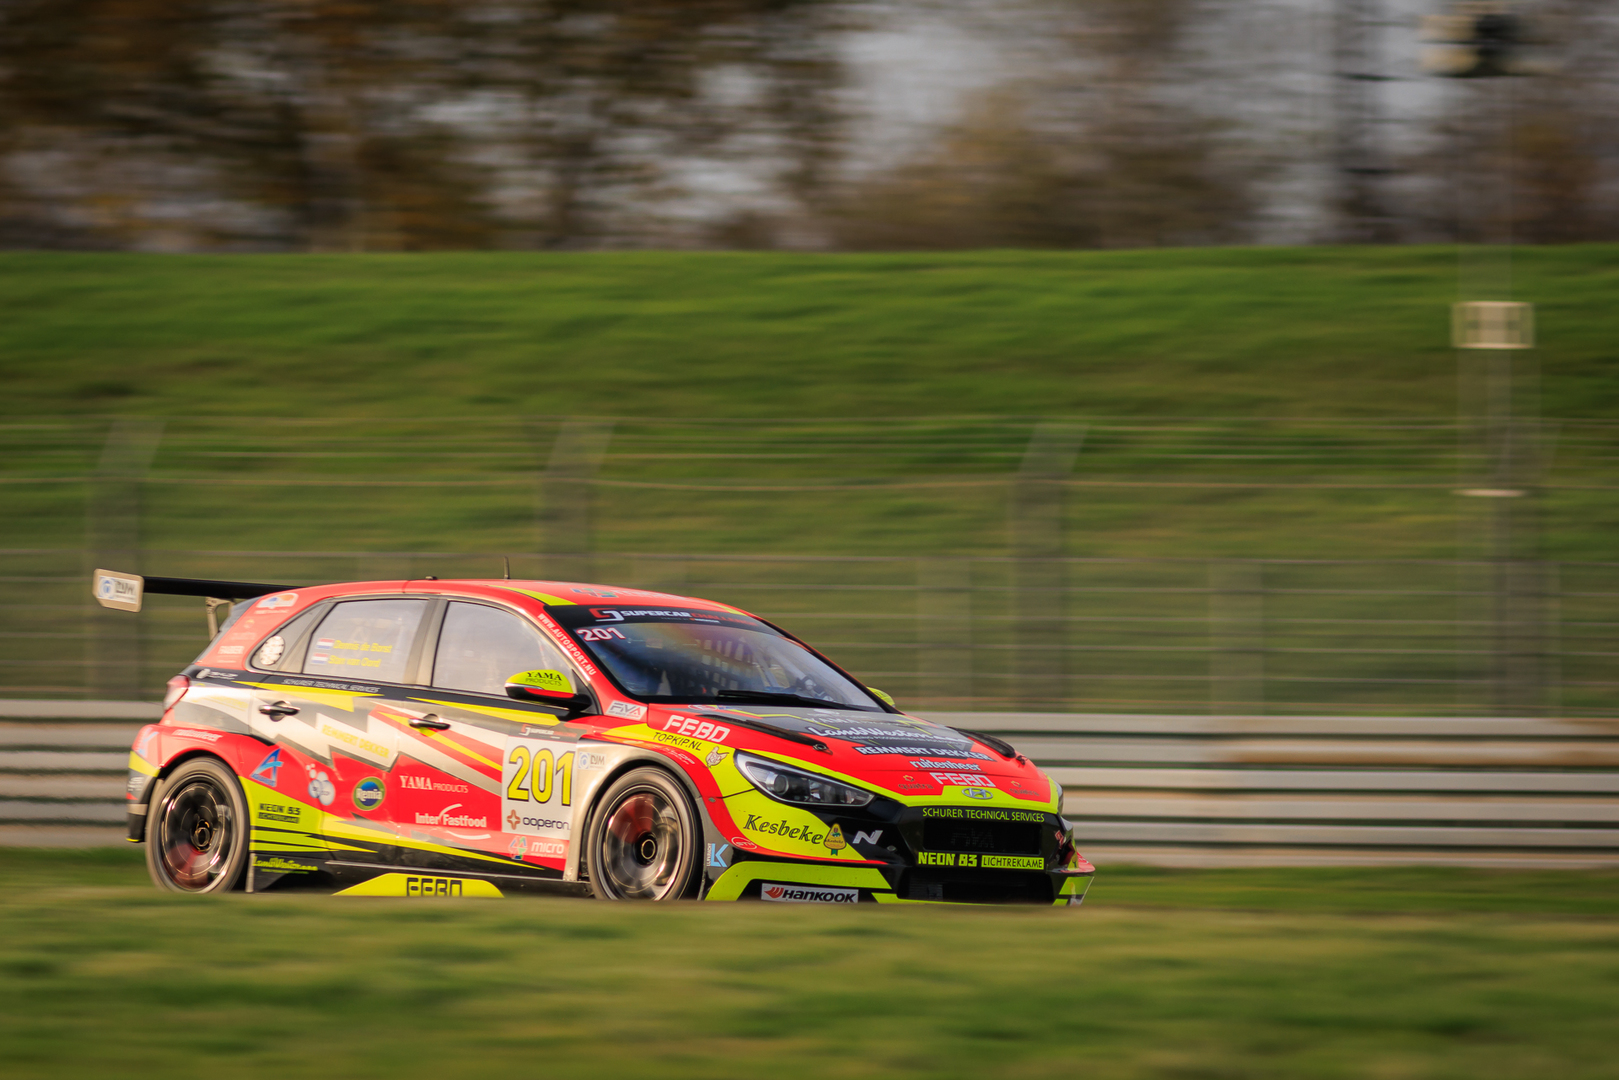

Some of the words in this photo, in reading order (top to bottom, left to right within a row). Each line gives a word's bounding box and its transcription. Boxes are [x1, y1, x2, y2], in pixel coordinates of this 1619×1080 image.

[622, 610, 692, 618] SUPERCAR
[576, 627, 626, 642] 201
[333, 639, 360, 651] Dennis
[360, 642, 370, 651] de
[537, 613, 596, 676] WWW.AUTOSPORT.NU
[525, 678, 563, 686] PRODUCTS
[527, 672, 563, 681] YAMA
[314, 681, 350, 690] TECHNICAL
[350, 684, 381, 693] SERVICES
[663, 714, 731, 743] FEBO
[322, 724, 359, 746] REMMERT
[358, 738, 390, 759] DEKKER
[653, 731, 702, 751] TOPKIP.NL
[858, 746, 933, 756] REMMERT
[933, 748, 998, 762] DEKKER
[909, 757, 983, 772] ruitenheer
[399, 775, 433, 790] YAMA
[433, 783, 469, 793] PRODUCTS
[507, 745, 576, 807] 201
[929, 772, 996, 788] FEBO
[356, 787, 382, 802] Remia
[259, 803, 285, 813] NEON
[922, 807, 963, 818] SCHURER
[965, 809, 1010, 820] TECHNICAL
[1011, 811, 1045, 823] SERVICES
[415, 812, 440, 825] Inter
[443, 813, 487, 827] Fastfood
[743, 813, 824, 845] Kesbeke
[530, 841, 565, 854] micro
[918, 851, 956, 866] NEON
[958, 854, 978, 867] 83
[982, 856, 1043, 869] LICHTREKLAME
[407, 877, 463, 896] FEBO
